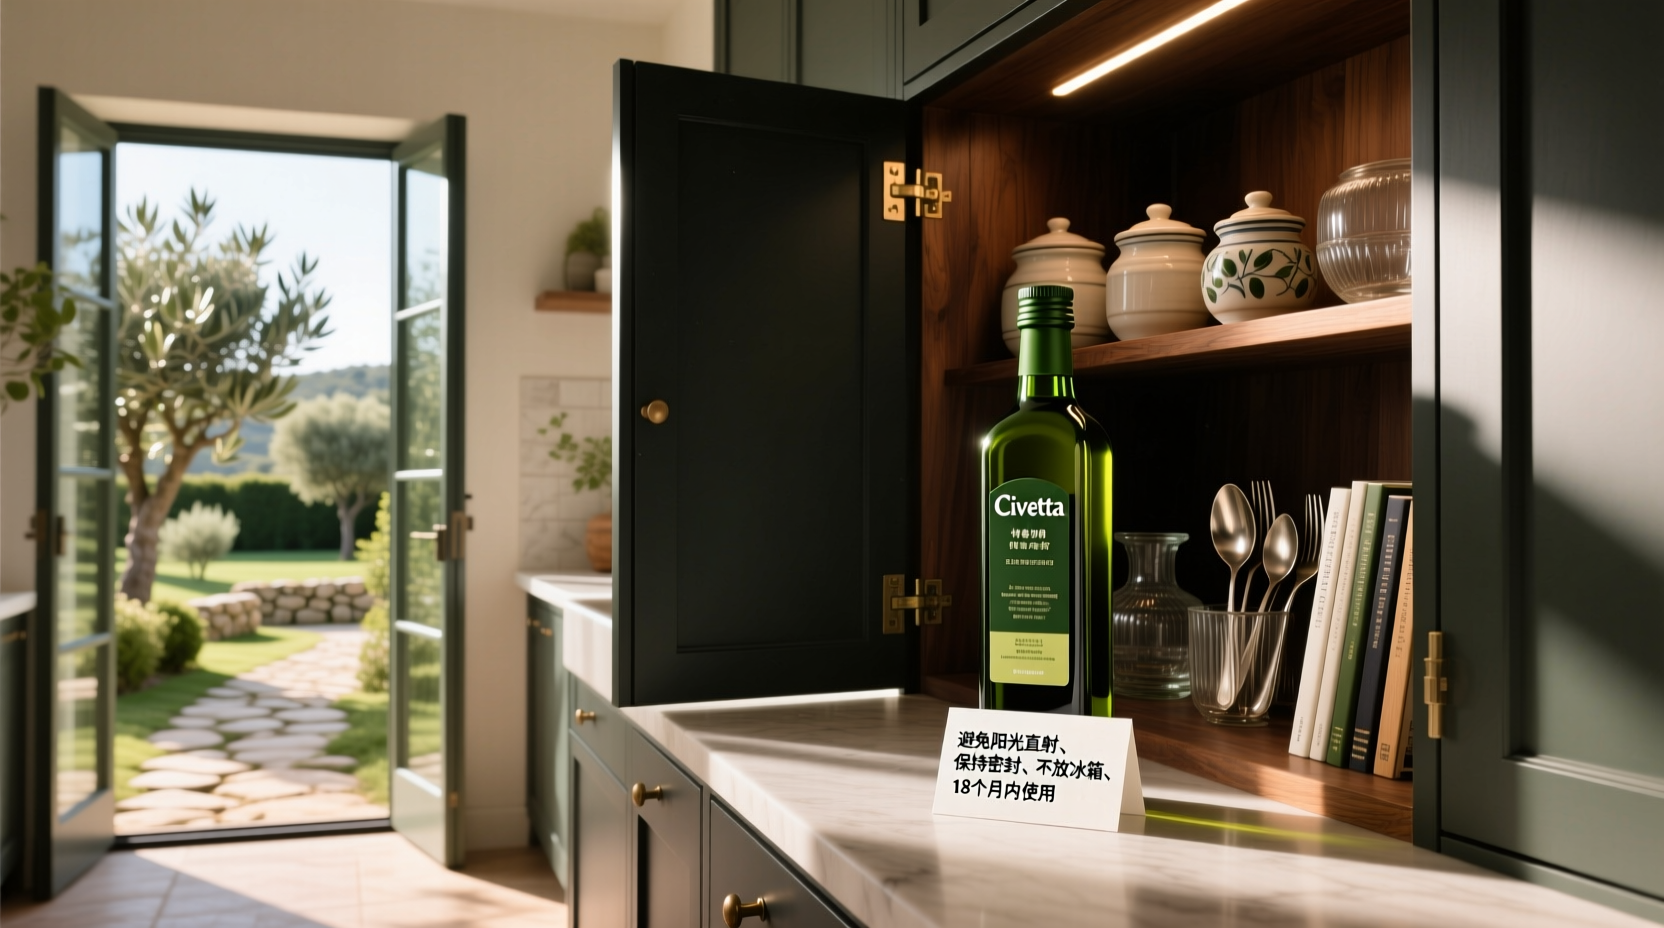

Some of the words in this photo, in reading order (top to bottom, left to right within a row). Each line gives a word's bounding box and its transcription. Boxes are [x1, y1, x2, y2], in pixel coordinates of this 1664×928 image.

[994, 494, 1065, 517] Civetta
[957, 731, 1067, 754] 避免阳光直射、
[954, 752, 1111, 781] 保持密封、不放冰箱、
[953, 779, 1056, 803] 18个月内使用
